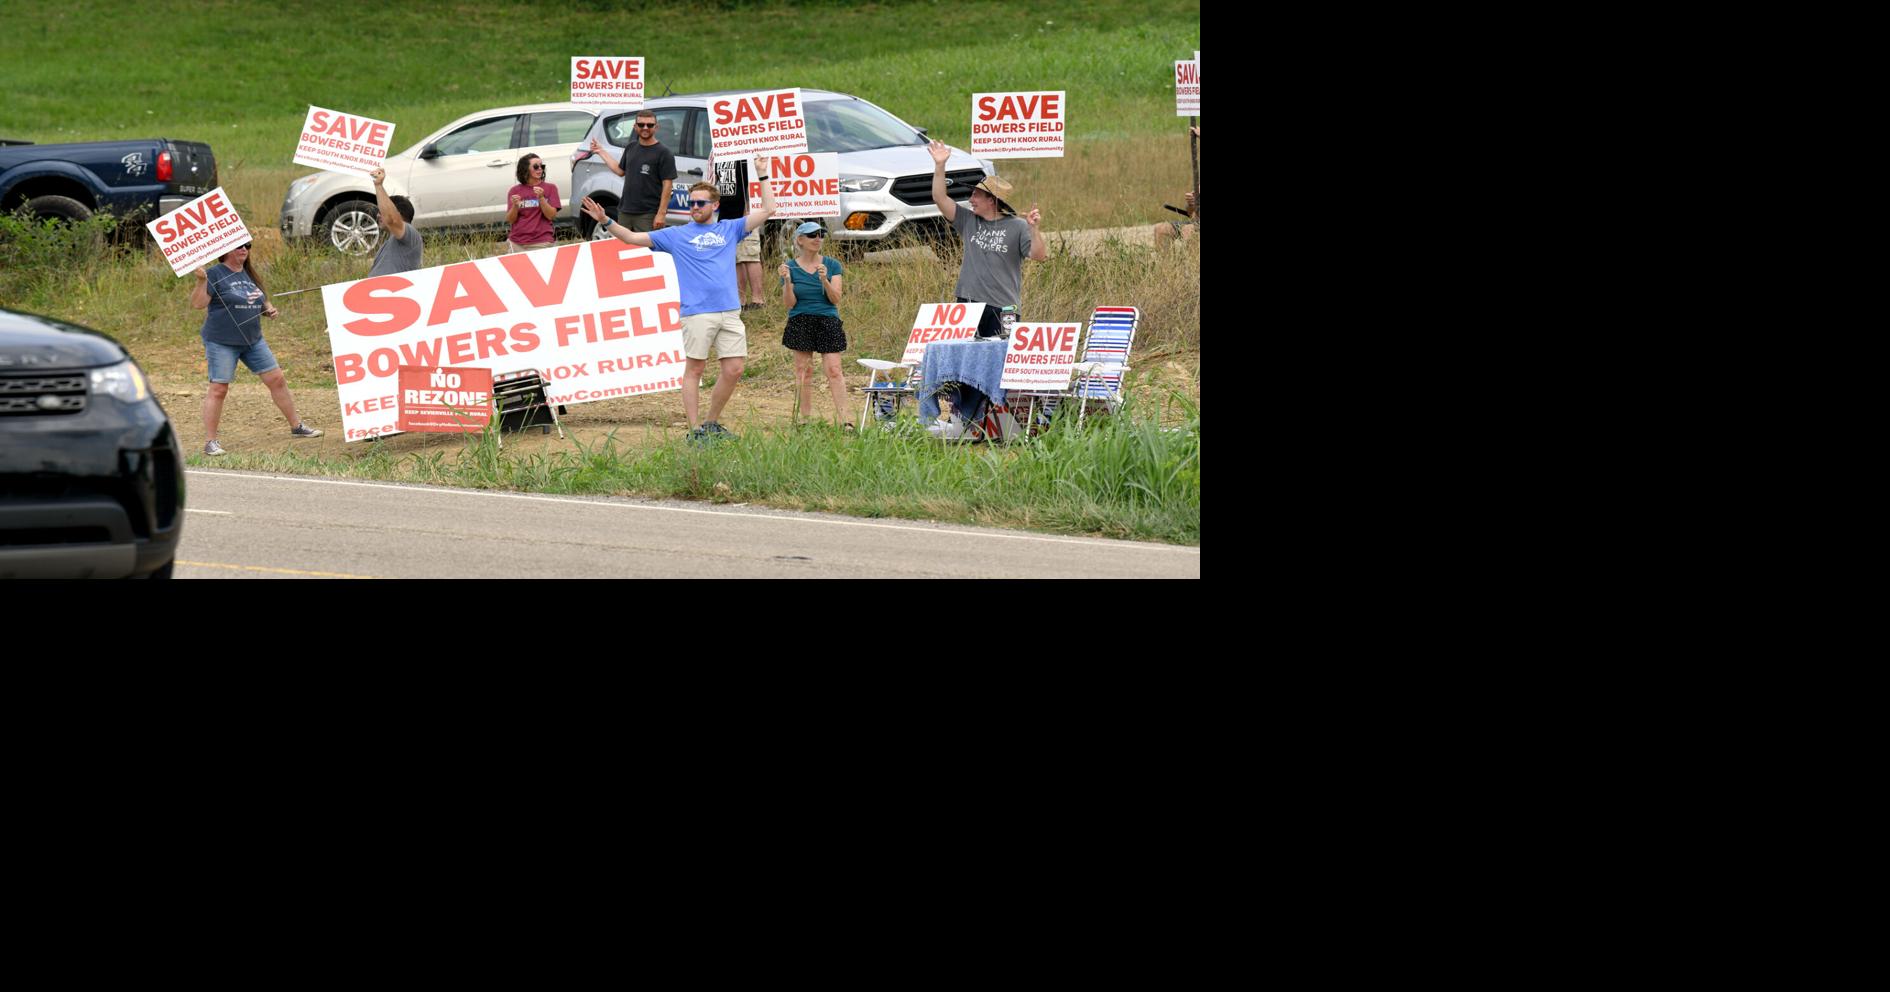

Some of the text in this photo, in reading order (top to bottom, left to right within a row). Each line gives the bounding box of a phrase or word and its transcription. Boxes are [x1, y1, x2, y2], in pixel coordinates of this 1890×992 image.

[576, 60, 639, 79] SAVE
[713, 92, 797, 125] SAVE
[978, 95, 1059, 121] SAVE
[310, 111, 389, 146] SAVE
[712, 119, 803, 138] BOWERS FIELD
[973, 122, 1063, 134] BOWERS FIELD
[301, 132, 385, 158] BOWERS FIELD
[713, 133, 805, 149] KEEP SOUTH KNOX RURAL
[298, 144, 381, 167] KEEP SOUTH KNOX RURAL
[771, 155, 815, 179] NO
[156, 193, 229, 243] SAVE
[163, 213, 239, 257] BOWERS FIELD
[170, 225, 244, 265] KEEP SOUTH KNOX RURAL
[343, 239, 666, 336] SAVE
[931, 304, 967, 325] NO
[335, 301, 682, 385] BOWERS FIELD
[1013, 326, 1076, 351] SAVE
[1006, 354, 1074, 364] BOWERS FIELD
[345, 395, 399, 416] KEE
[598, 350, 686, 374] RURAL
[431, 373, 461, 388] NO
[404, 389, 488, 406] REZONE
